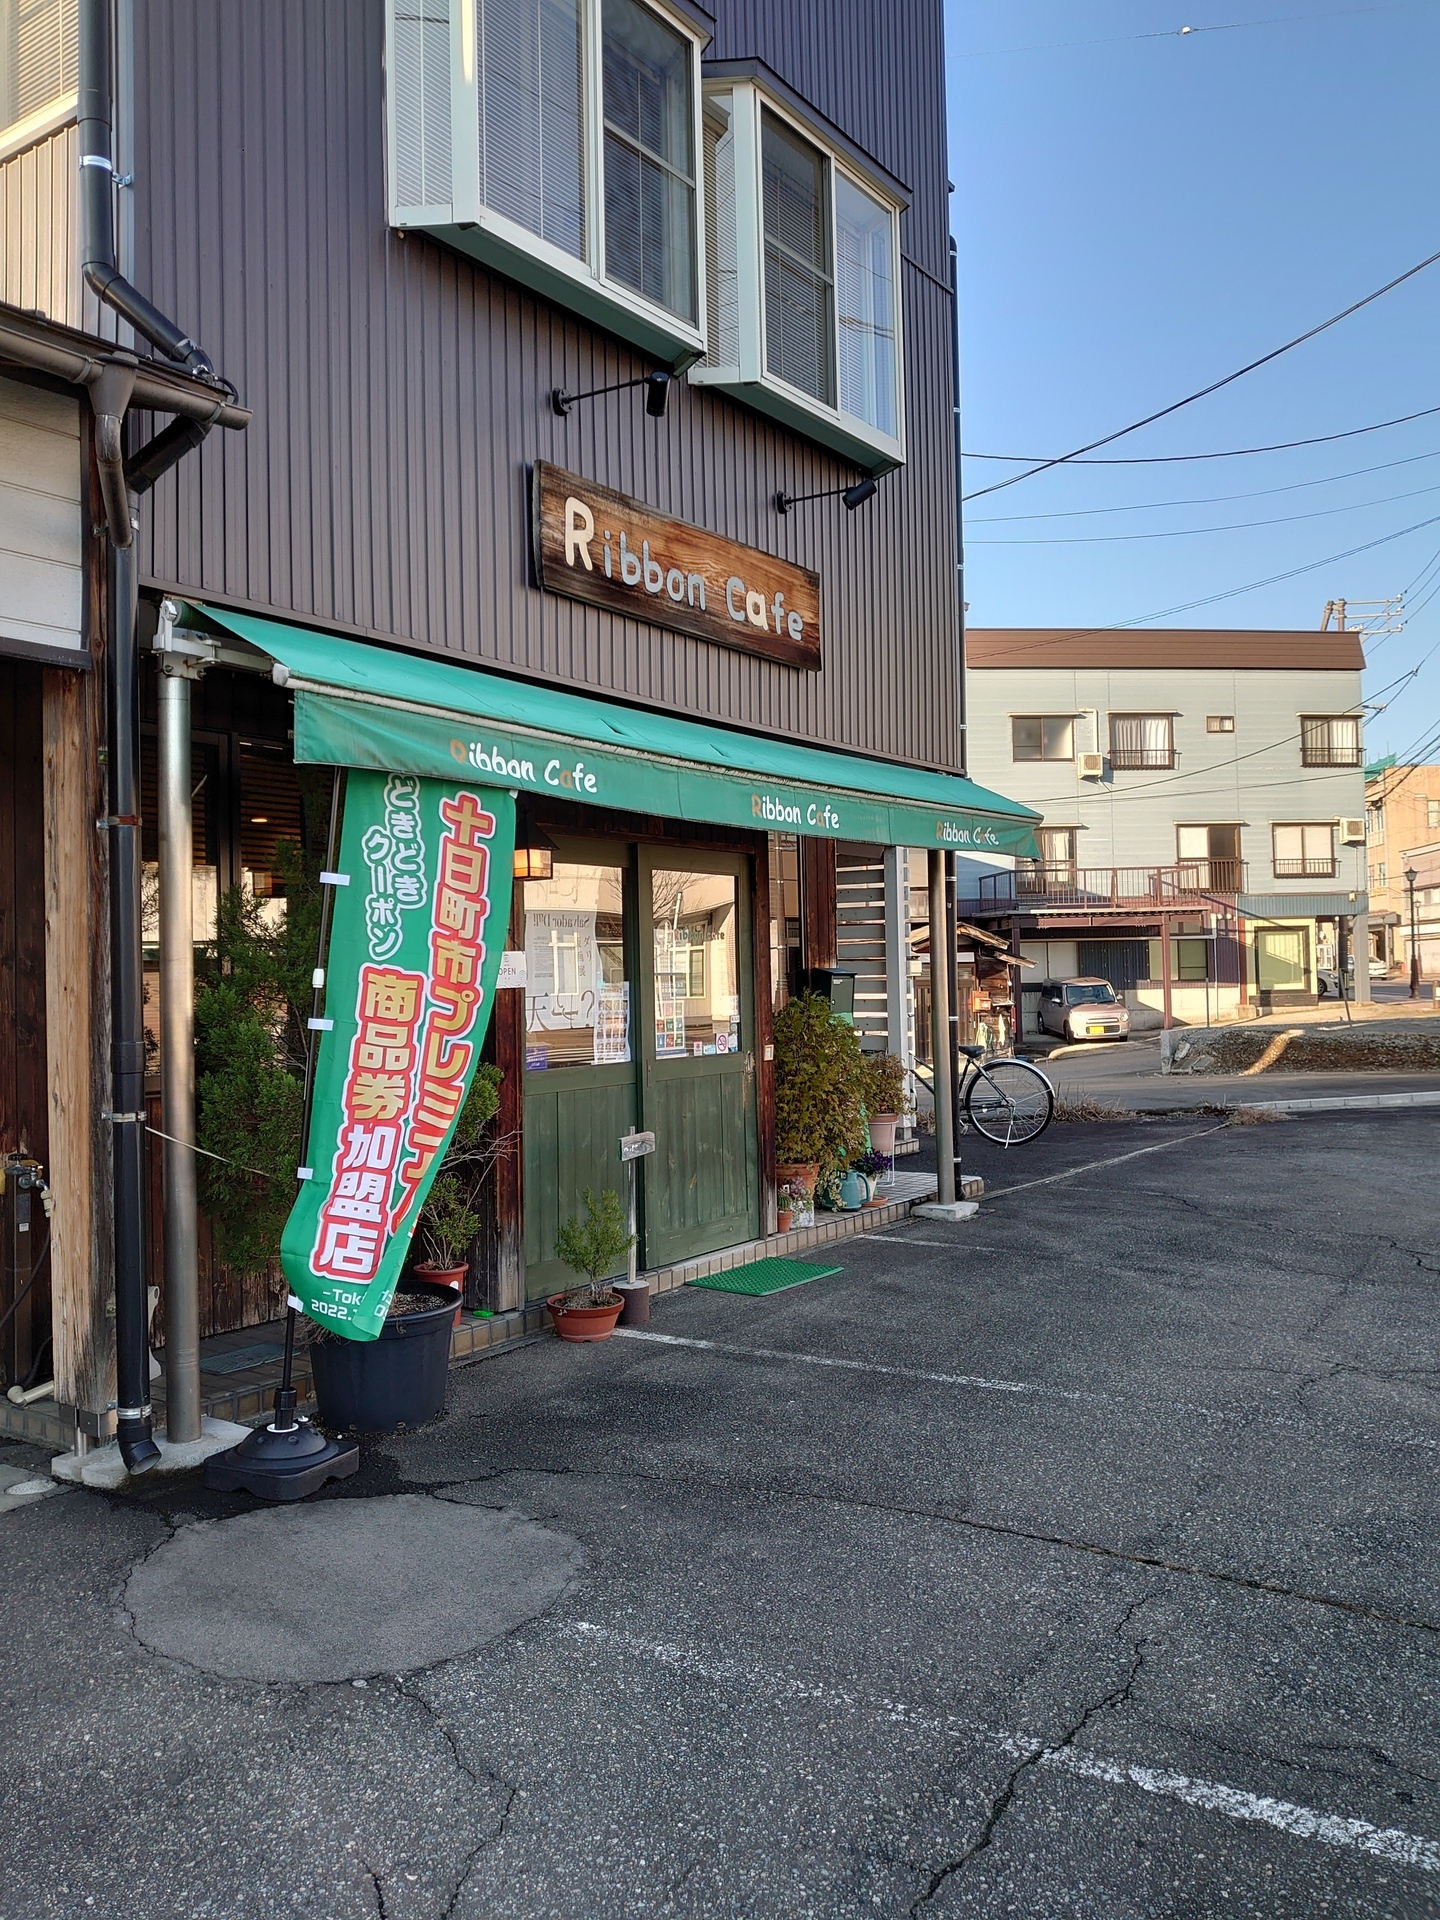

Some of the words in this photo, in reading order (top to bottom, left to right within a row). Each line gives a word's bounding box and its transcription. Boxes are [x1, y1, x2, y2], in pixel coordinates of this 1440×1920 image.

[564, 496, 706, 611] Ribbon
[726, 576, 804, 641] Cafe
[544, 759, 598, 793] Cafe
[751, 793, 802, 825] Ribbon
[806, 803, 840, 829] Cafe
[388, 778, 421, 903] どきどき
[936, 820, 972, 844] Ribbon
[973, 826, 1000, 846] Cafe
[368, 833, 397, 953] クーポン
[498, 967, 516, 976] OPEN
[319, 972, 418, 1274] 商品券加盟店
